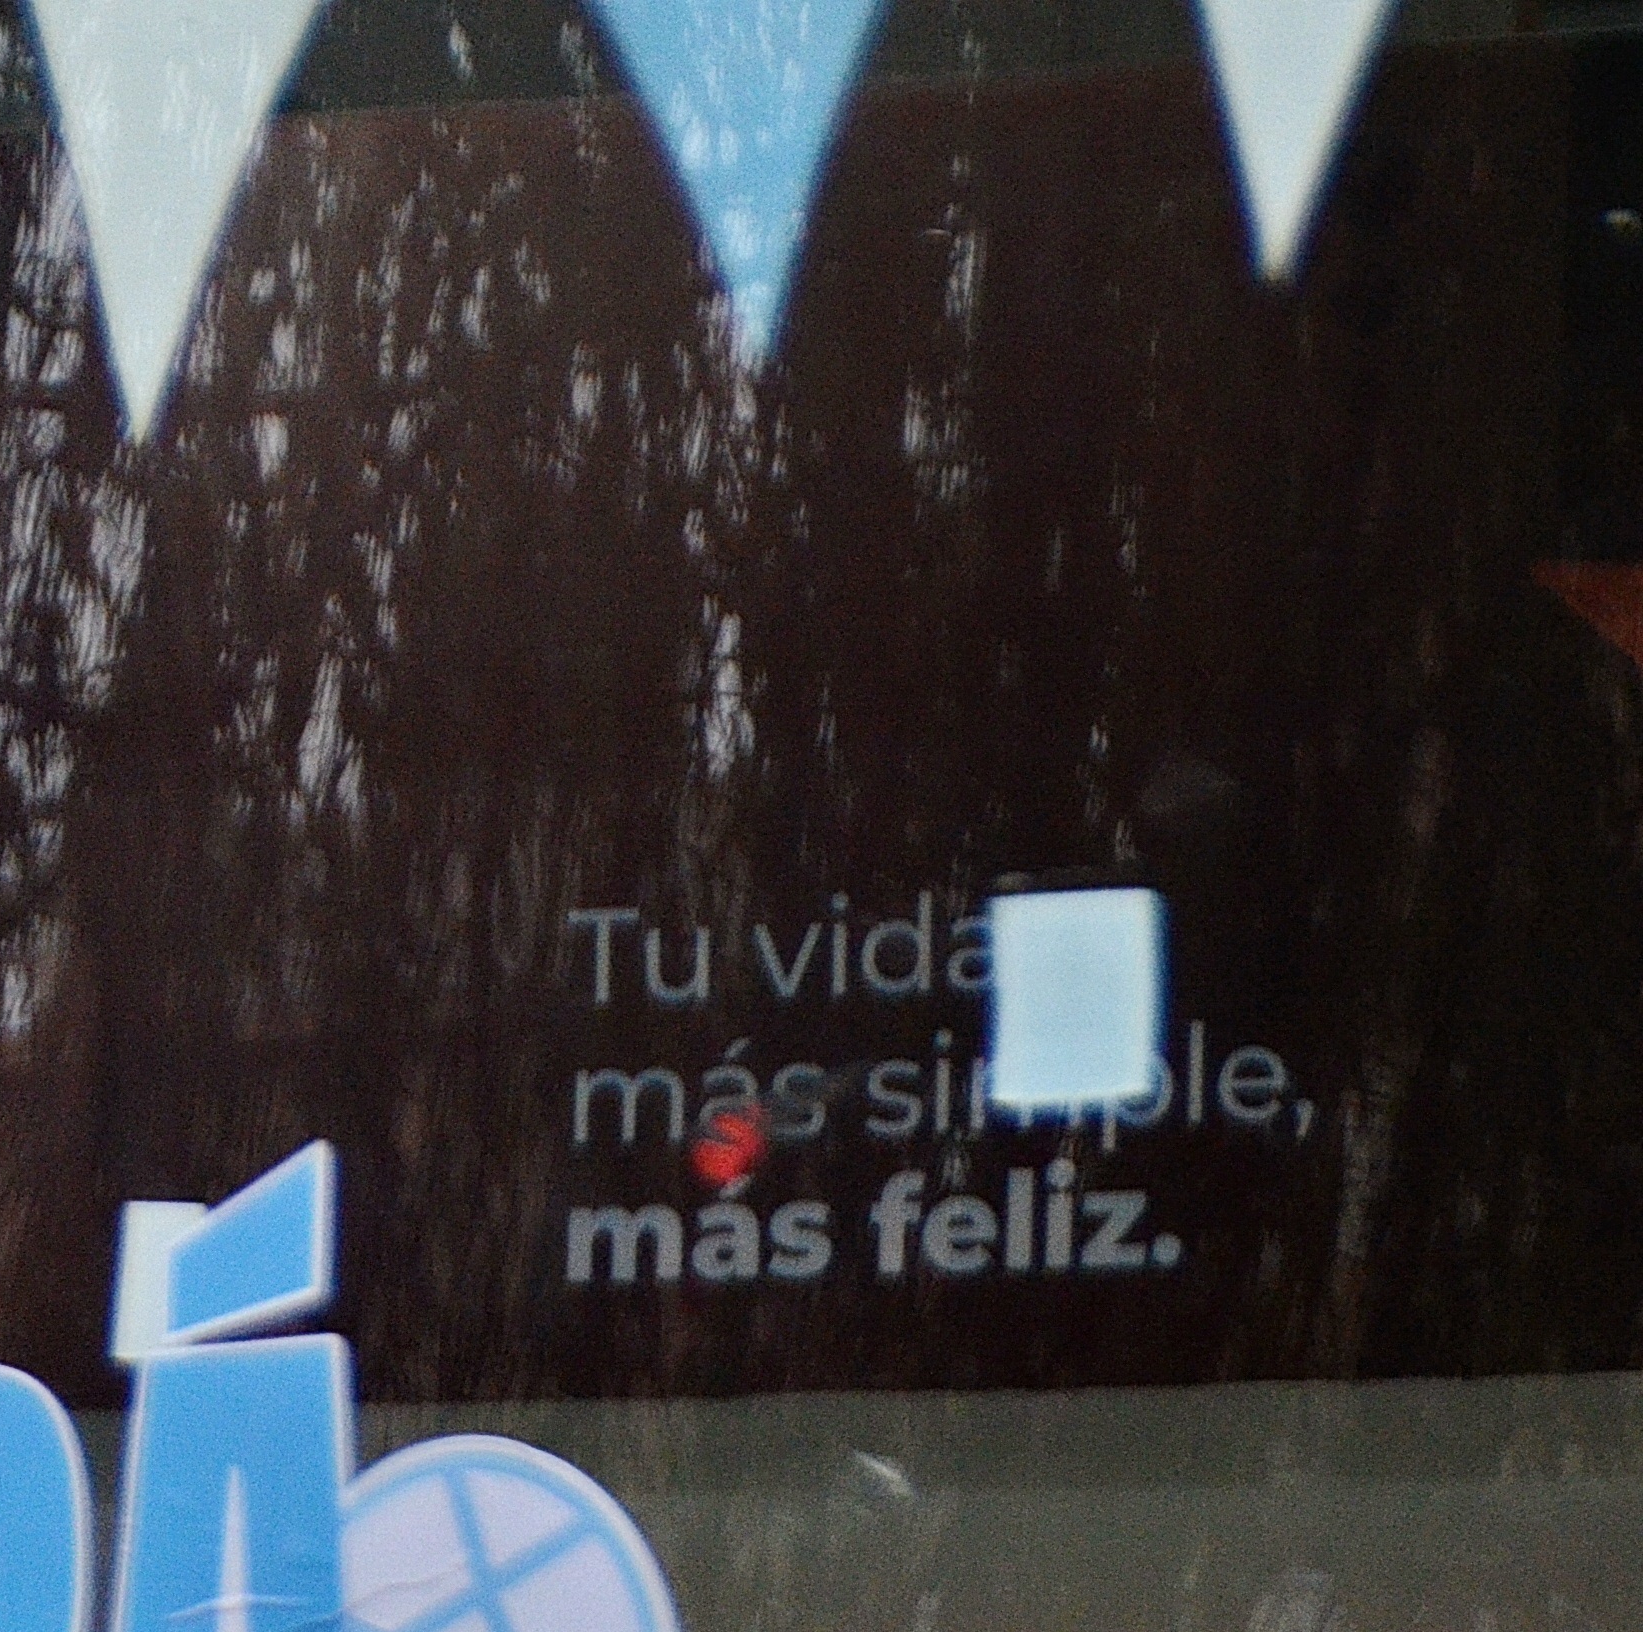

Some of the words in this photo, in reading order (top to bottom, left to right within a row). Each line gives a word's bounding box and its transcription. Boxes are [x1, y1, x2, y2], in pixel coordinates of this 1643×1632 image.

[568, 905, 712, 1004] Tu
[751, 892, 998, 1000] vida
[572, 1037, 827, 1146] más
[565, 1173, 834, 1283] más
[868, 1155, 1183, 1275] feliz.
